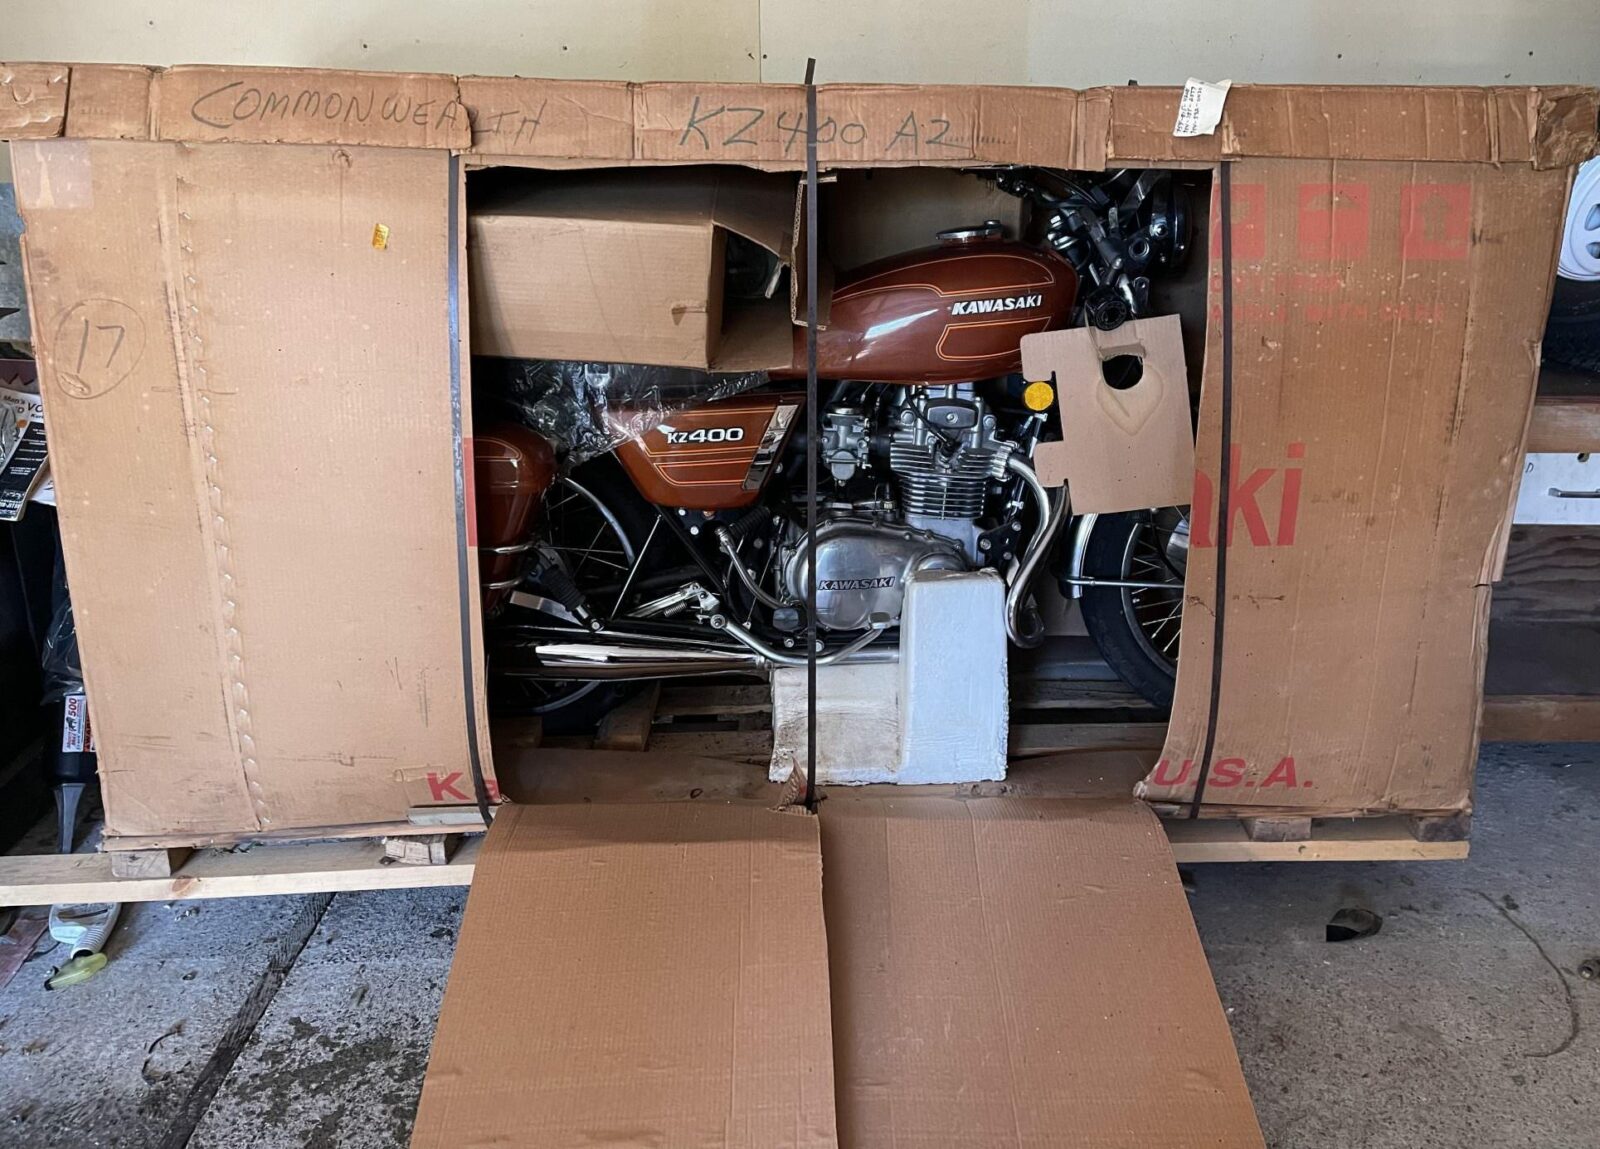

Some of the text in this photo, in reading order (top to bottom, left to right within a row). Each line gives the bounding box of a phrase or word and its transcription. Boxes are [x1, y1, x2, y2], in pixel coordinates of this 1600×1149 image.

[951, 295, 1042, 315] KAWASAKI
[76, 318, 125, 374] 17
[667, 427, 744, 444] KZ400
[818, 576, 895, 590] KAWASAKI
[68, 698, 77, 717] 500
[1153, 755, 1313, 788] U.S.A.
